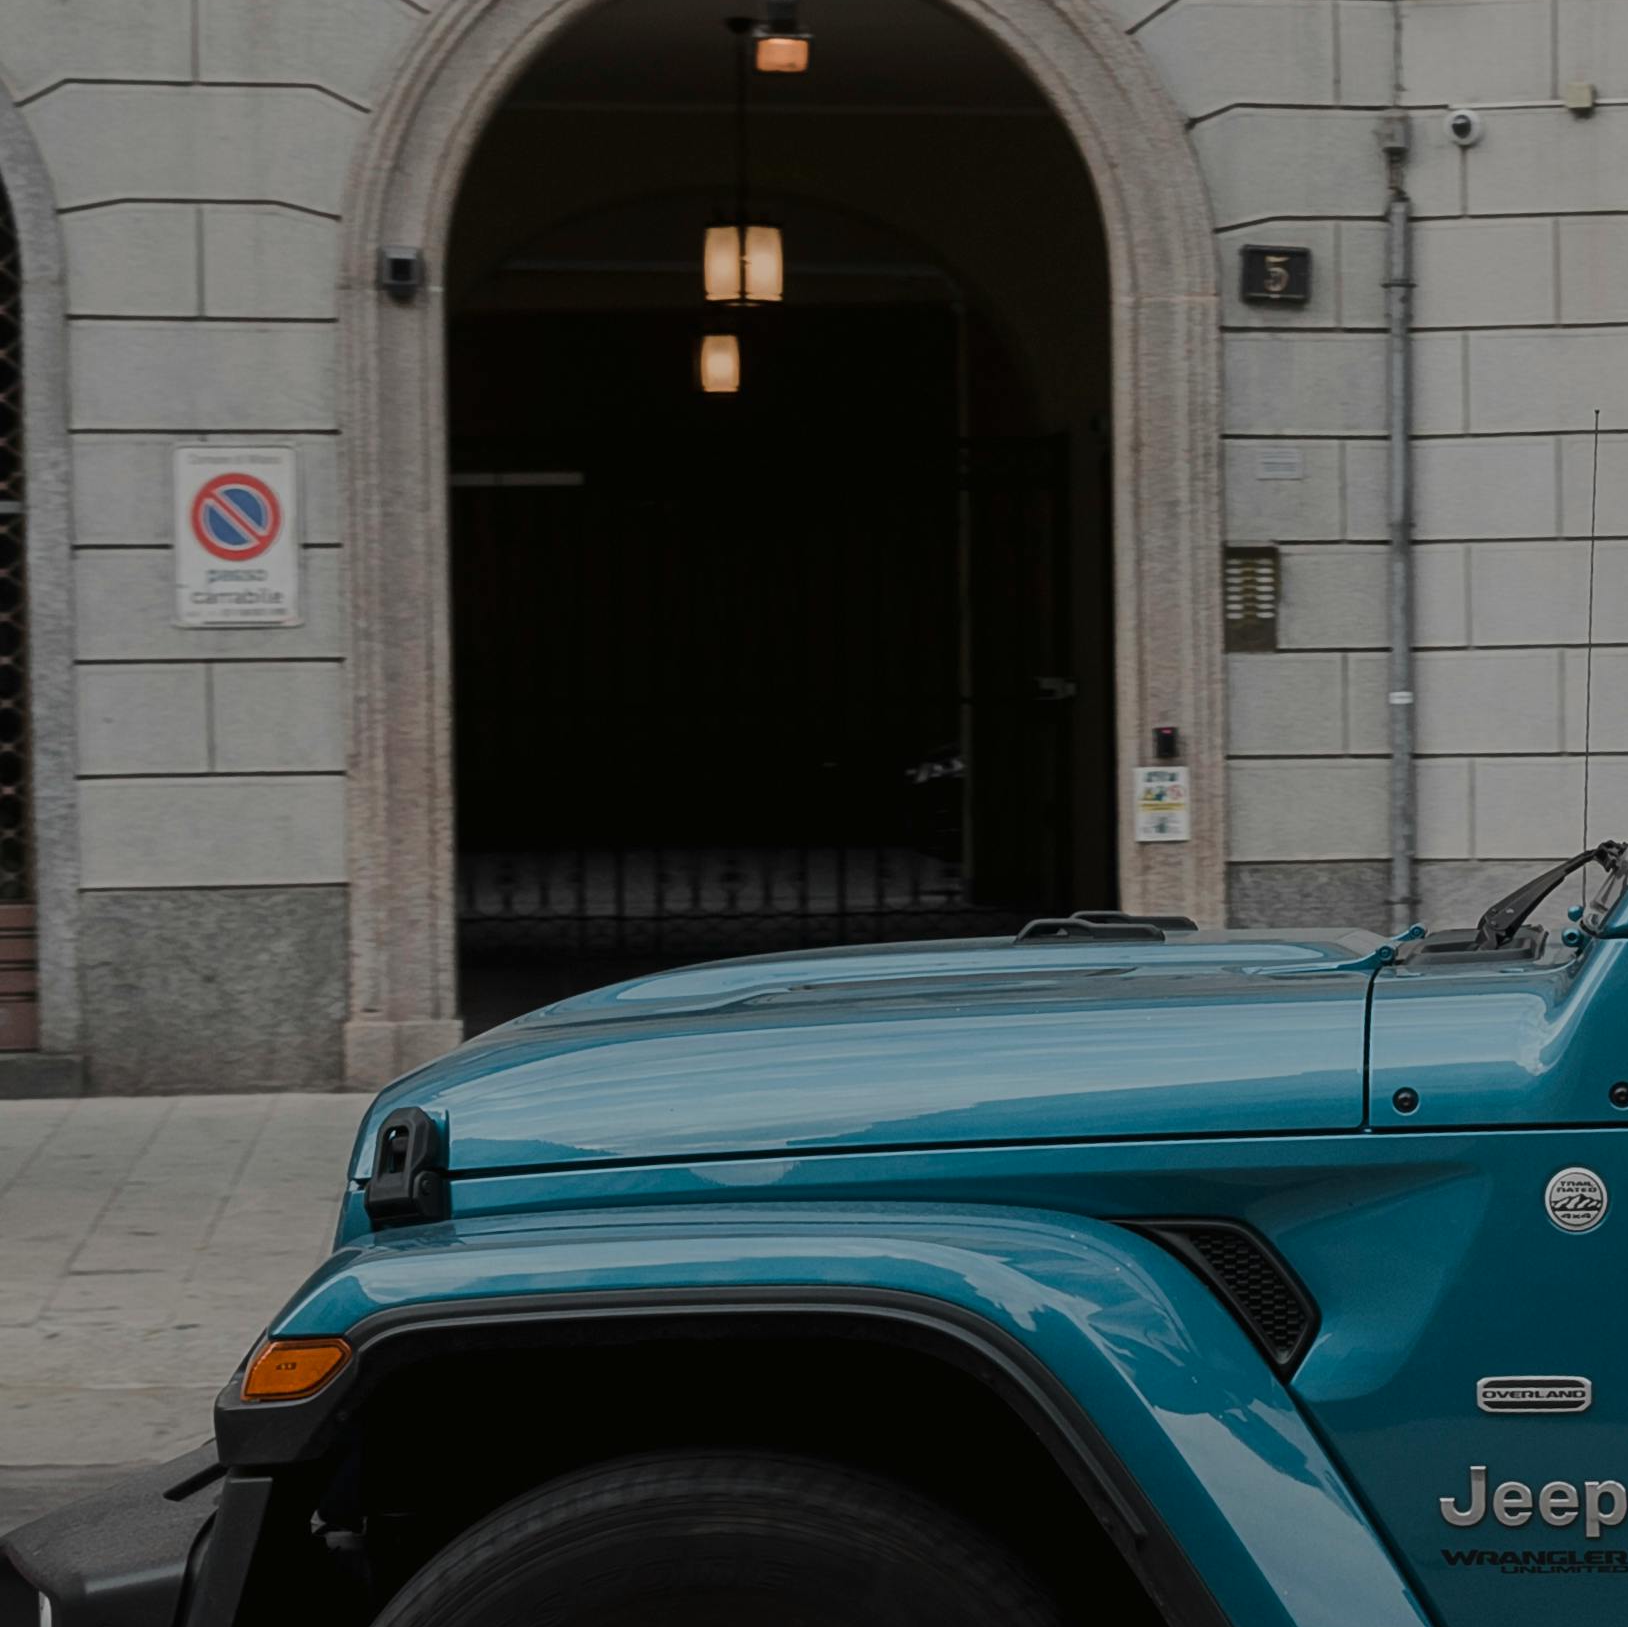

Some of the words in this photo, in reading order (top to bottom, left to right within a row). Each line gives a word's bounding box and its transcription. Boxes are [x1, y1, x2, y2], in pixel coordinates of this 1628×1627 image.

[1264, 254, 1291, 292] 5
[191, 587, 285, 604] carrabile
[1560, 1180, 1593, 1188] TRAIL
[1481, 1389, 1586, 1399] OVERLAND
[1438, 1464, 1628, 1538] Jeep
[1440, 1549, 1628, 1566] WRANGLER
